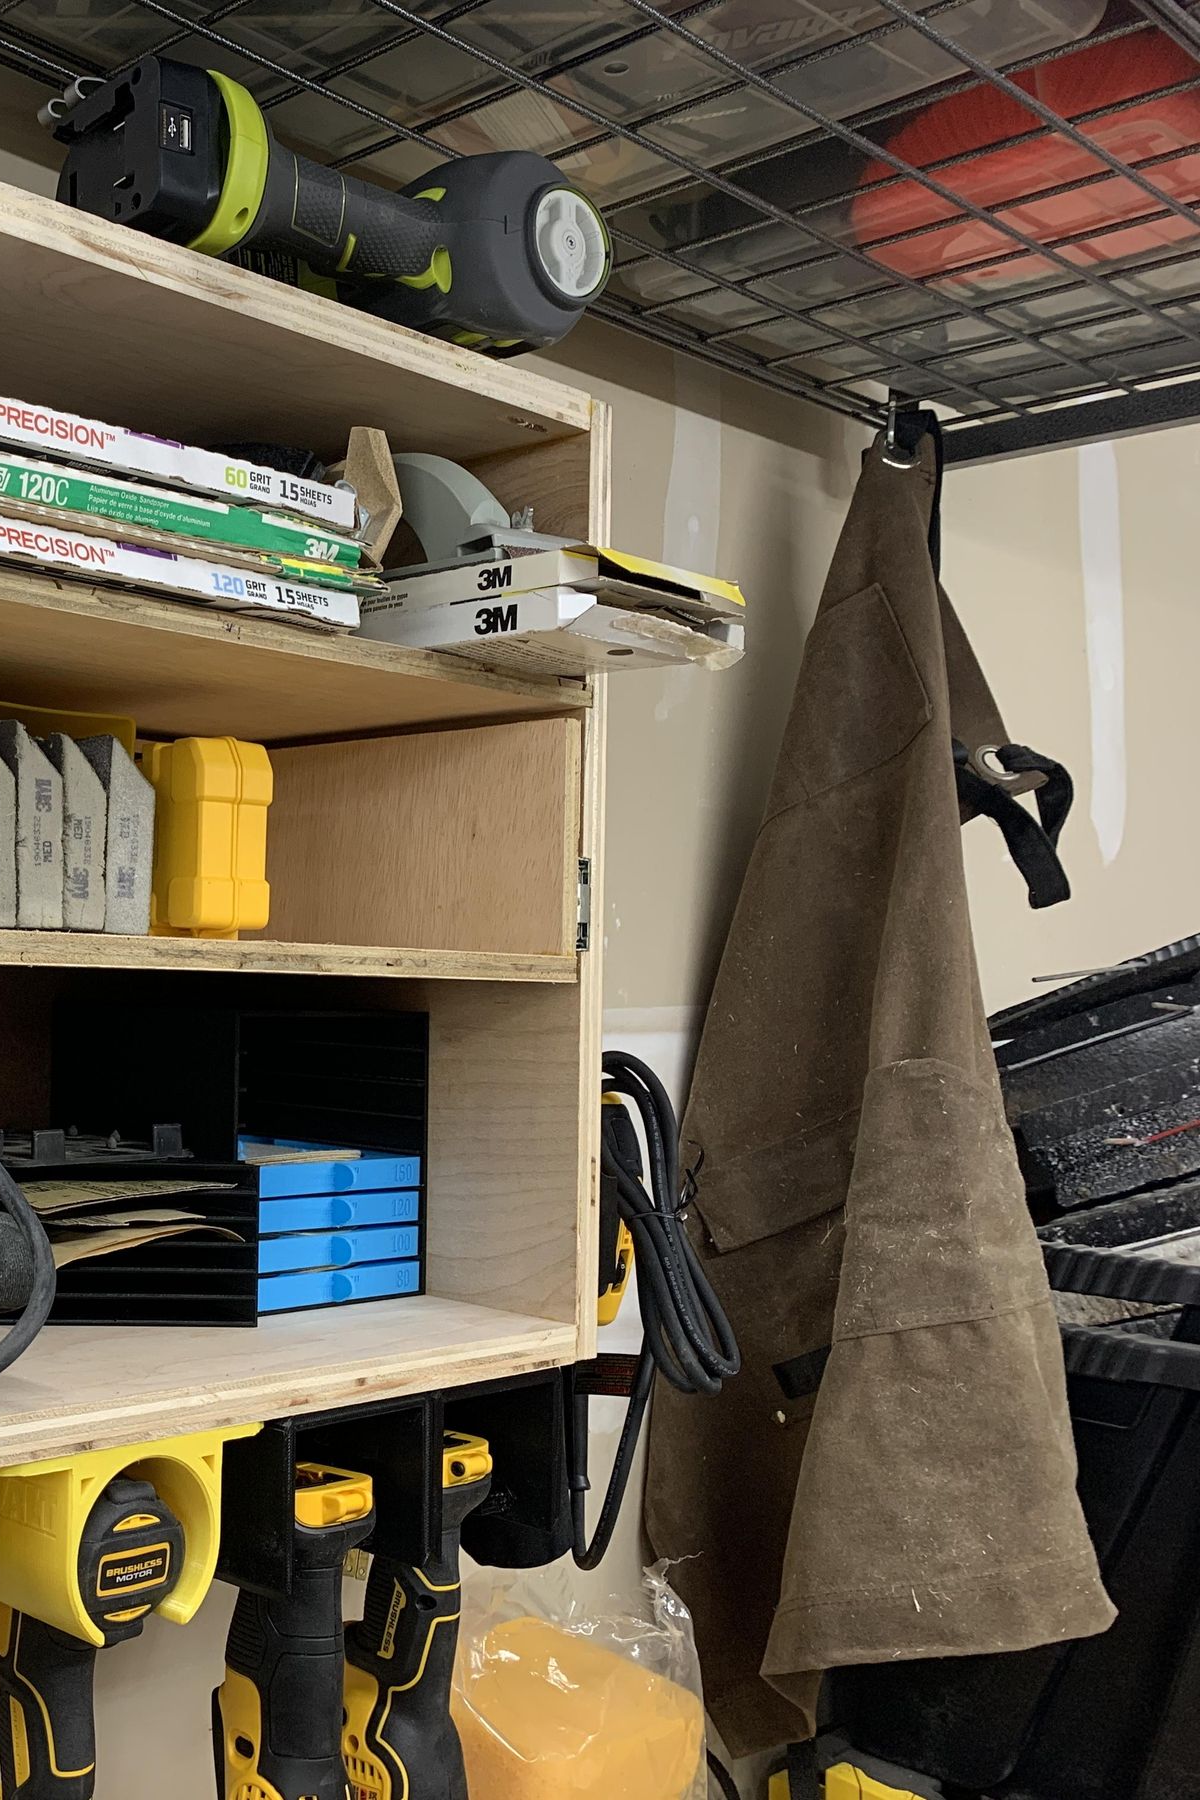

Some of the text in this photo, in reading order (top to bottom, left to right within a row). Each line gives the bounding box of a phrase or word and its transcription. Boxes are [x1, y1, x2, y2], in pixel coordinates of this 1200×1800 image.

[19, 471, 69, 506] 120C
[225, 466, 271, 488] 60 GRIT
[90, 485, 170, 509] Aluminum Oxide Sandpaper
[280, 479, 333, 504] 15 SHEETS
[87, 504, 98, 513] Lija
[99, 506, 107, 515] de
[125, 512, 134, 520] de
[88, 494, 108, 506] Papier
[118, 503, 133, 511] verre
[139, 505, 153, 515] base
[304, 538, 339, 563] 3M
[211, 573, 267, 596] 120 GRIT
[477, 565, 512, 591] 3M
[275, 586, 329, 607] 15 SHEETS
[474, 603, 518, 635] 3M
[34, 778, 52, 813] 3M
[73, 817, 84, 840] MED
[42, 840, 52, 863] MED
[71, 867, 89, 900] 3M
[391, 1198, 410, 1217] 120
[391, 1234, 410, 1252] 100
[397, 1269, 409, 1288] 80
[106, 1558, 163, 1577] BRUSHLESS
[116, 1569, 153, 1583] MOTOR
[383, 1590, 402, 1653] BRUSHLESS
